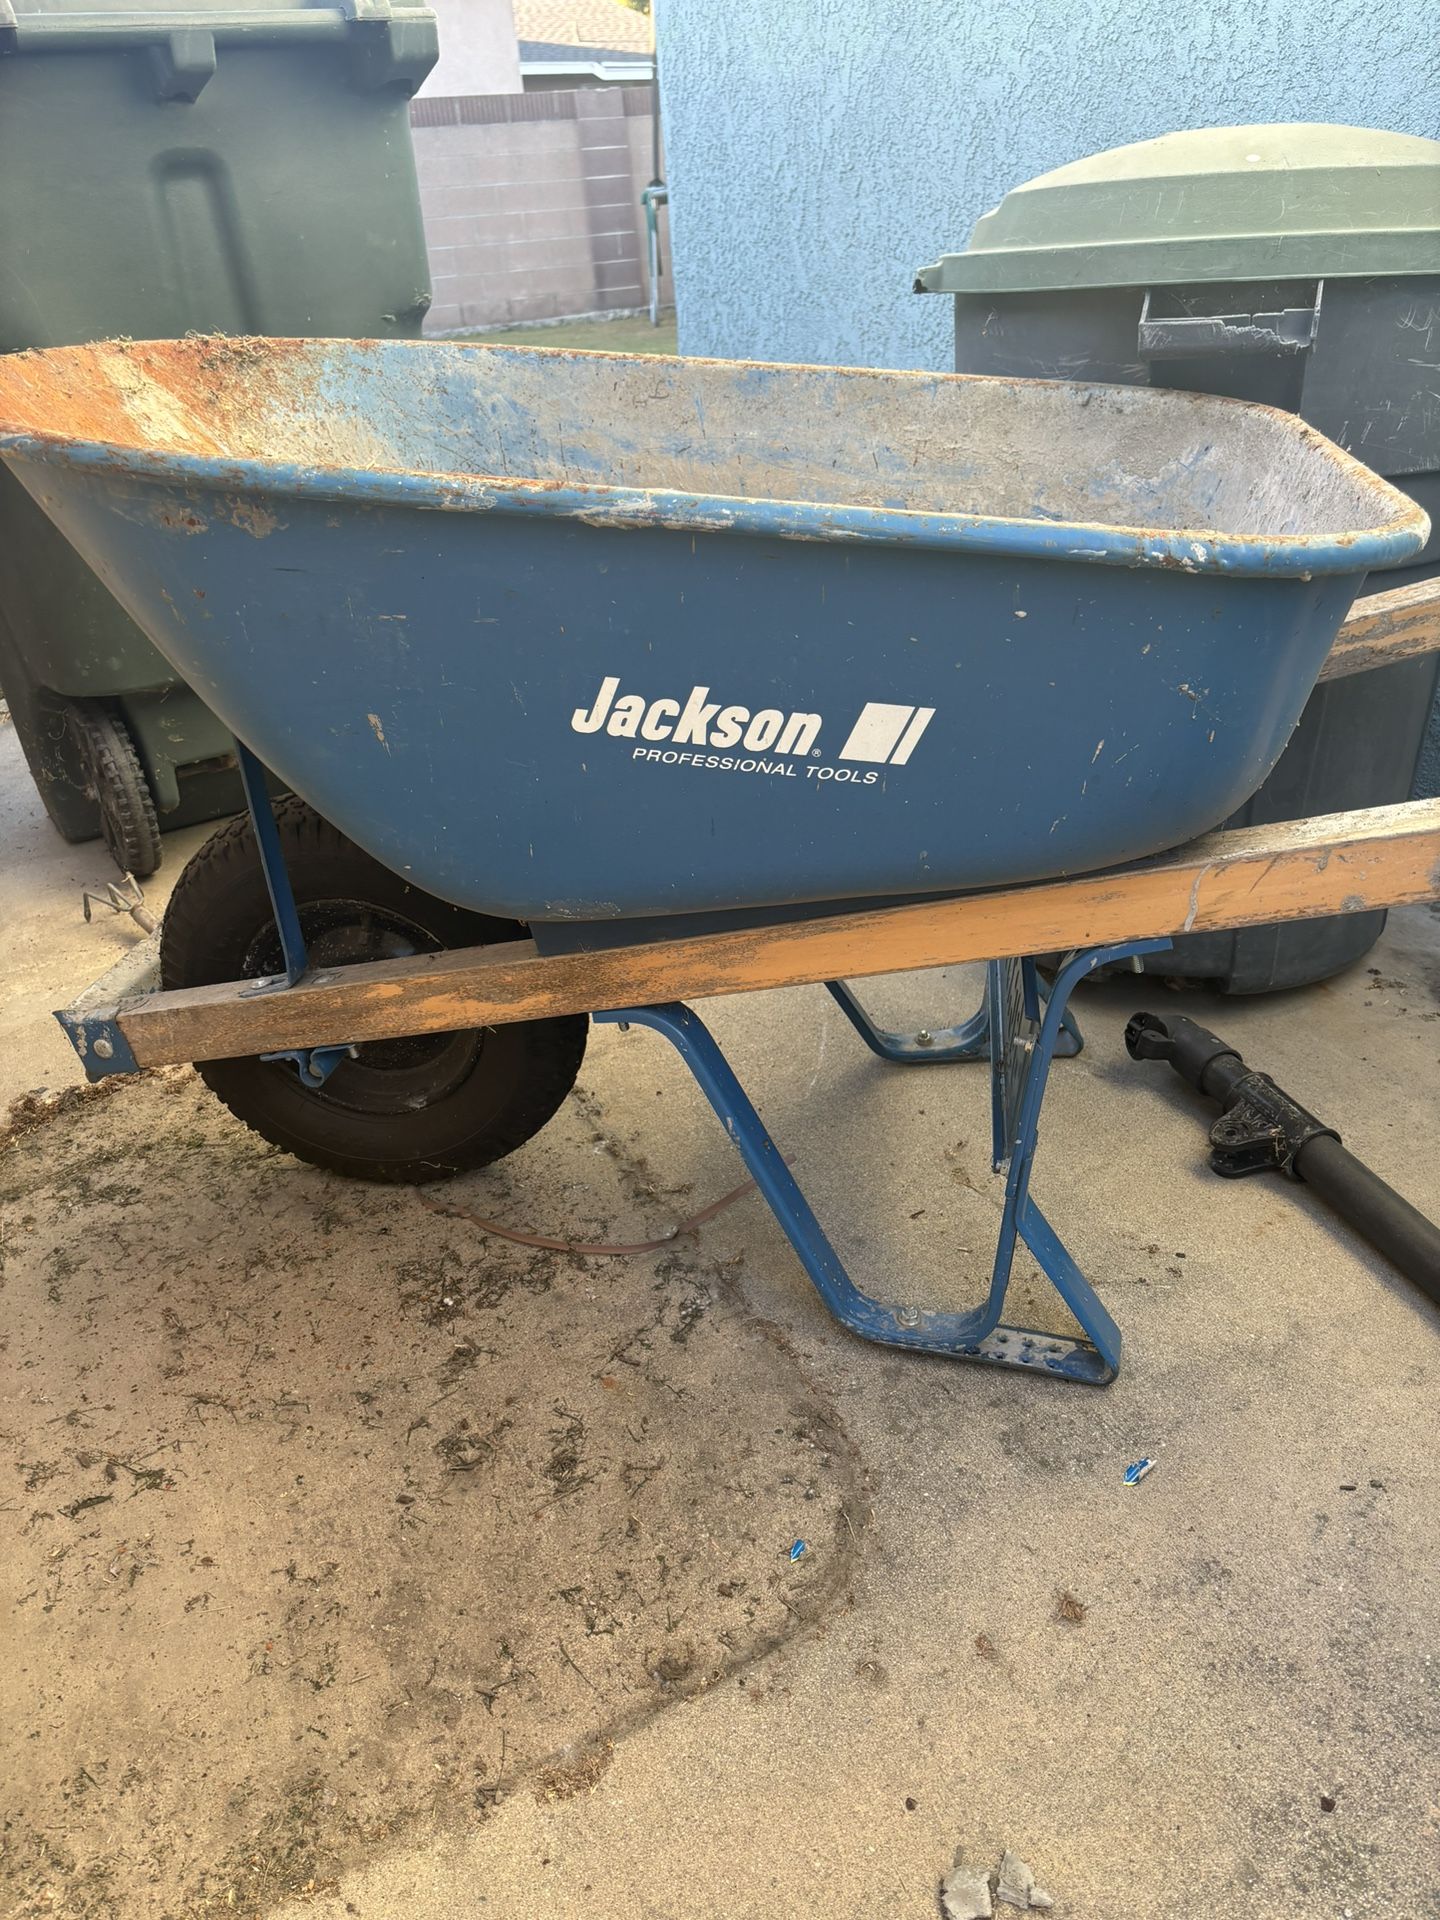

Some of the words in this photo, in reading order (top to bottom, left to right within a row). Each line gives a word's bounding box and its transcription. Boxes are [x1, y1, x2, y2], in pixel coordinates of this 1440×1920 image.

[570, 676, 822, 756] Jackson
[632, 747, 797, 777] PROFESSIONAL
[806, 766, 879, 785] TOOLS
